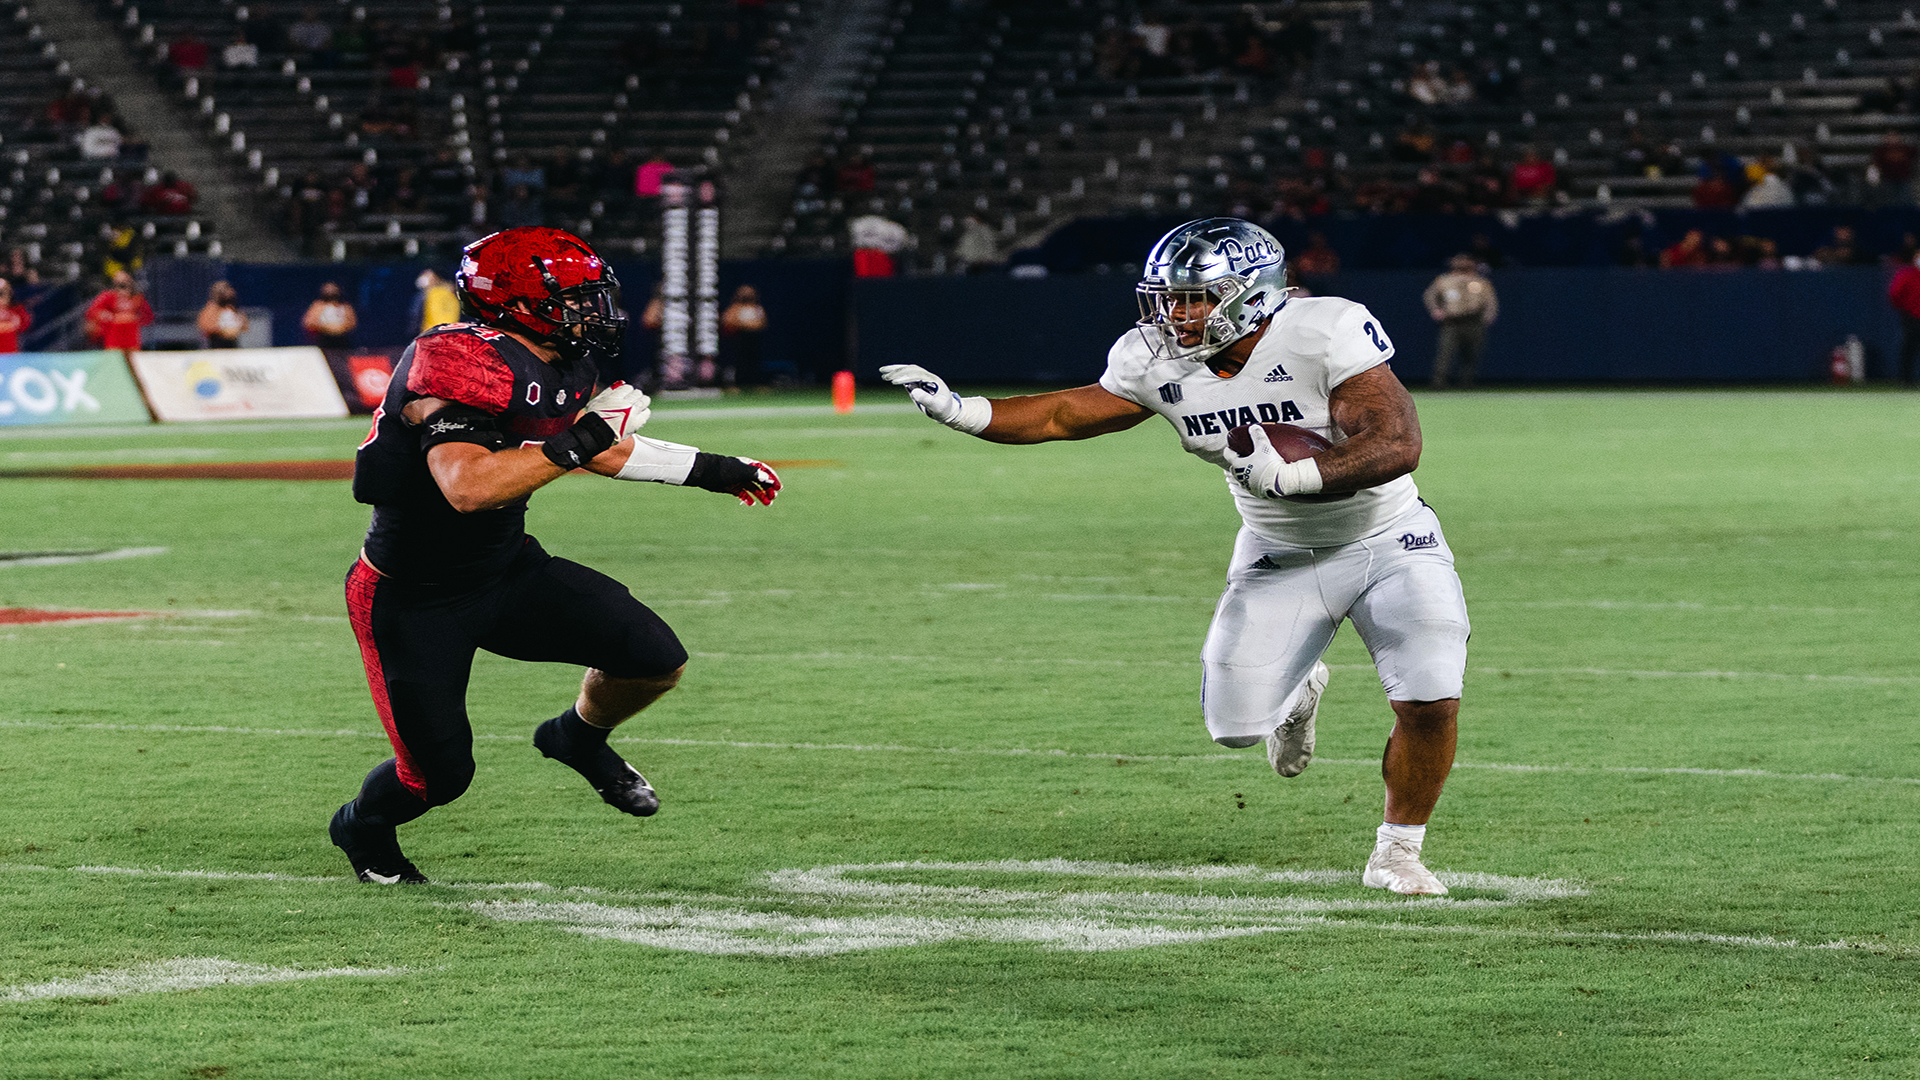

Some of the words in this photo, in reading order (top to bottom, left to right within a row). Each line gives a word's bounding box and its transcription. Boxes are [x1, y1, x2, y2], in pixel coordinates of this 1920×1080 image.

[1210, 231, 1281, 277] Pack
[1363, 321, 1389, 352] 2
[1263, 375, 1294, 383] adidas
[1182, 400, 1304, 437] NEVADA
[1396, 531, 1439, 551] Pack
